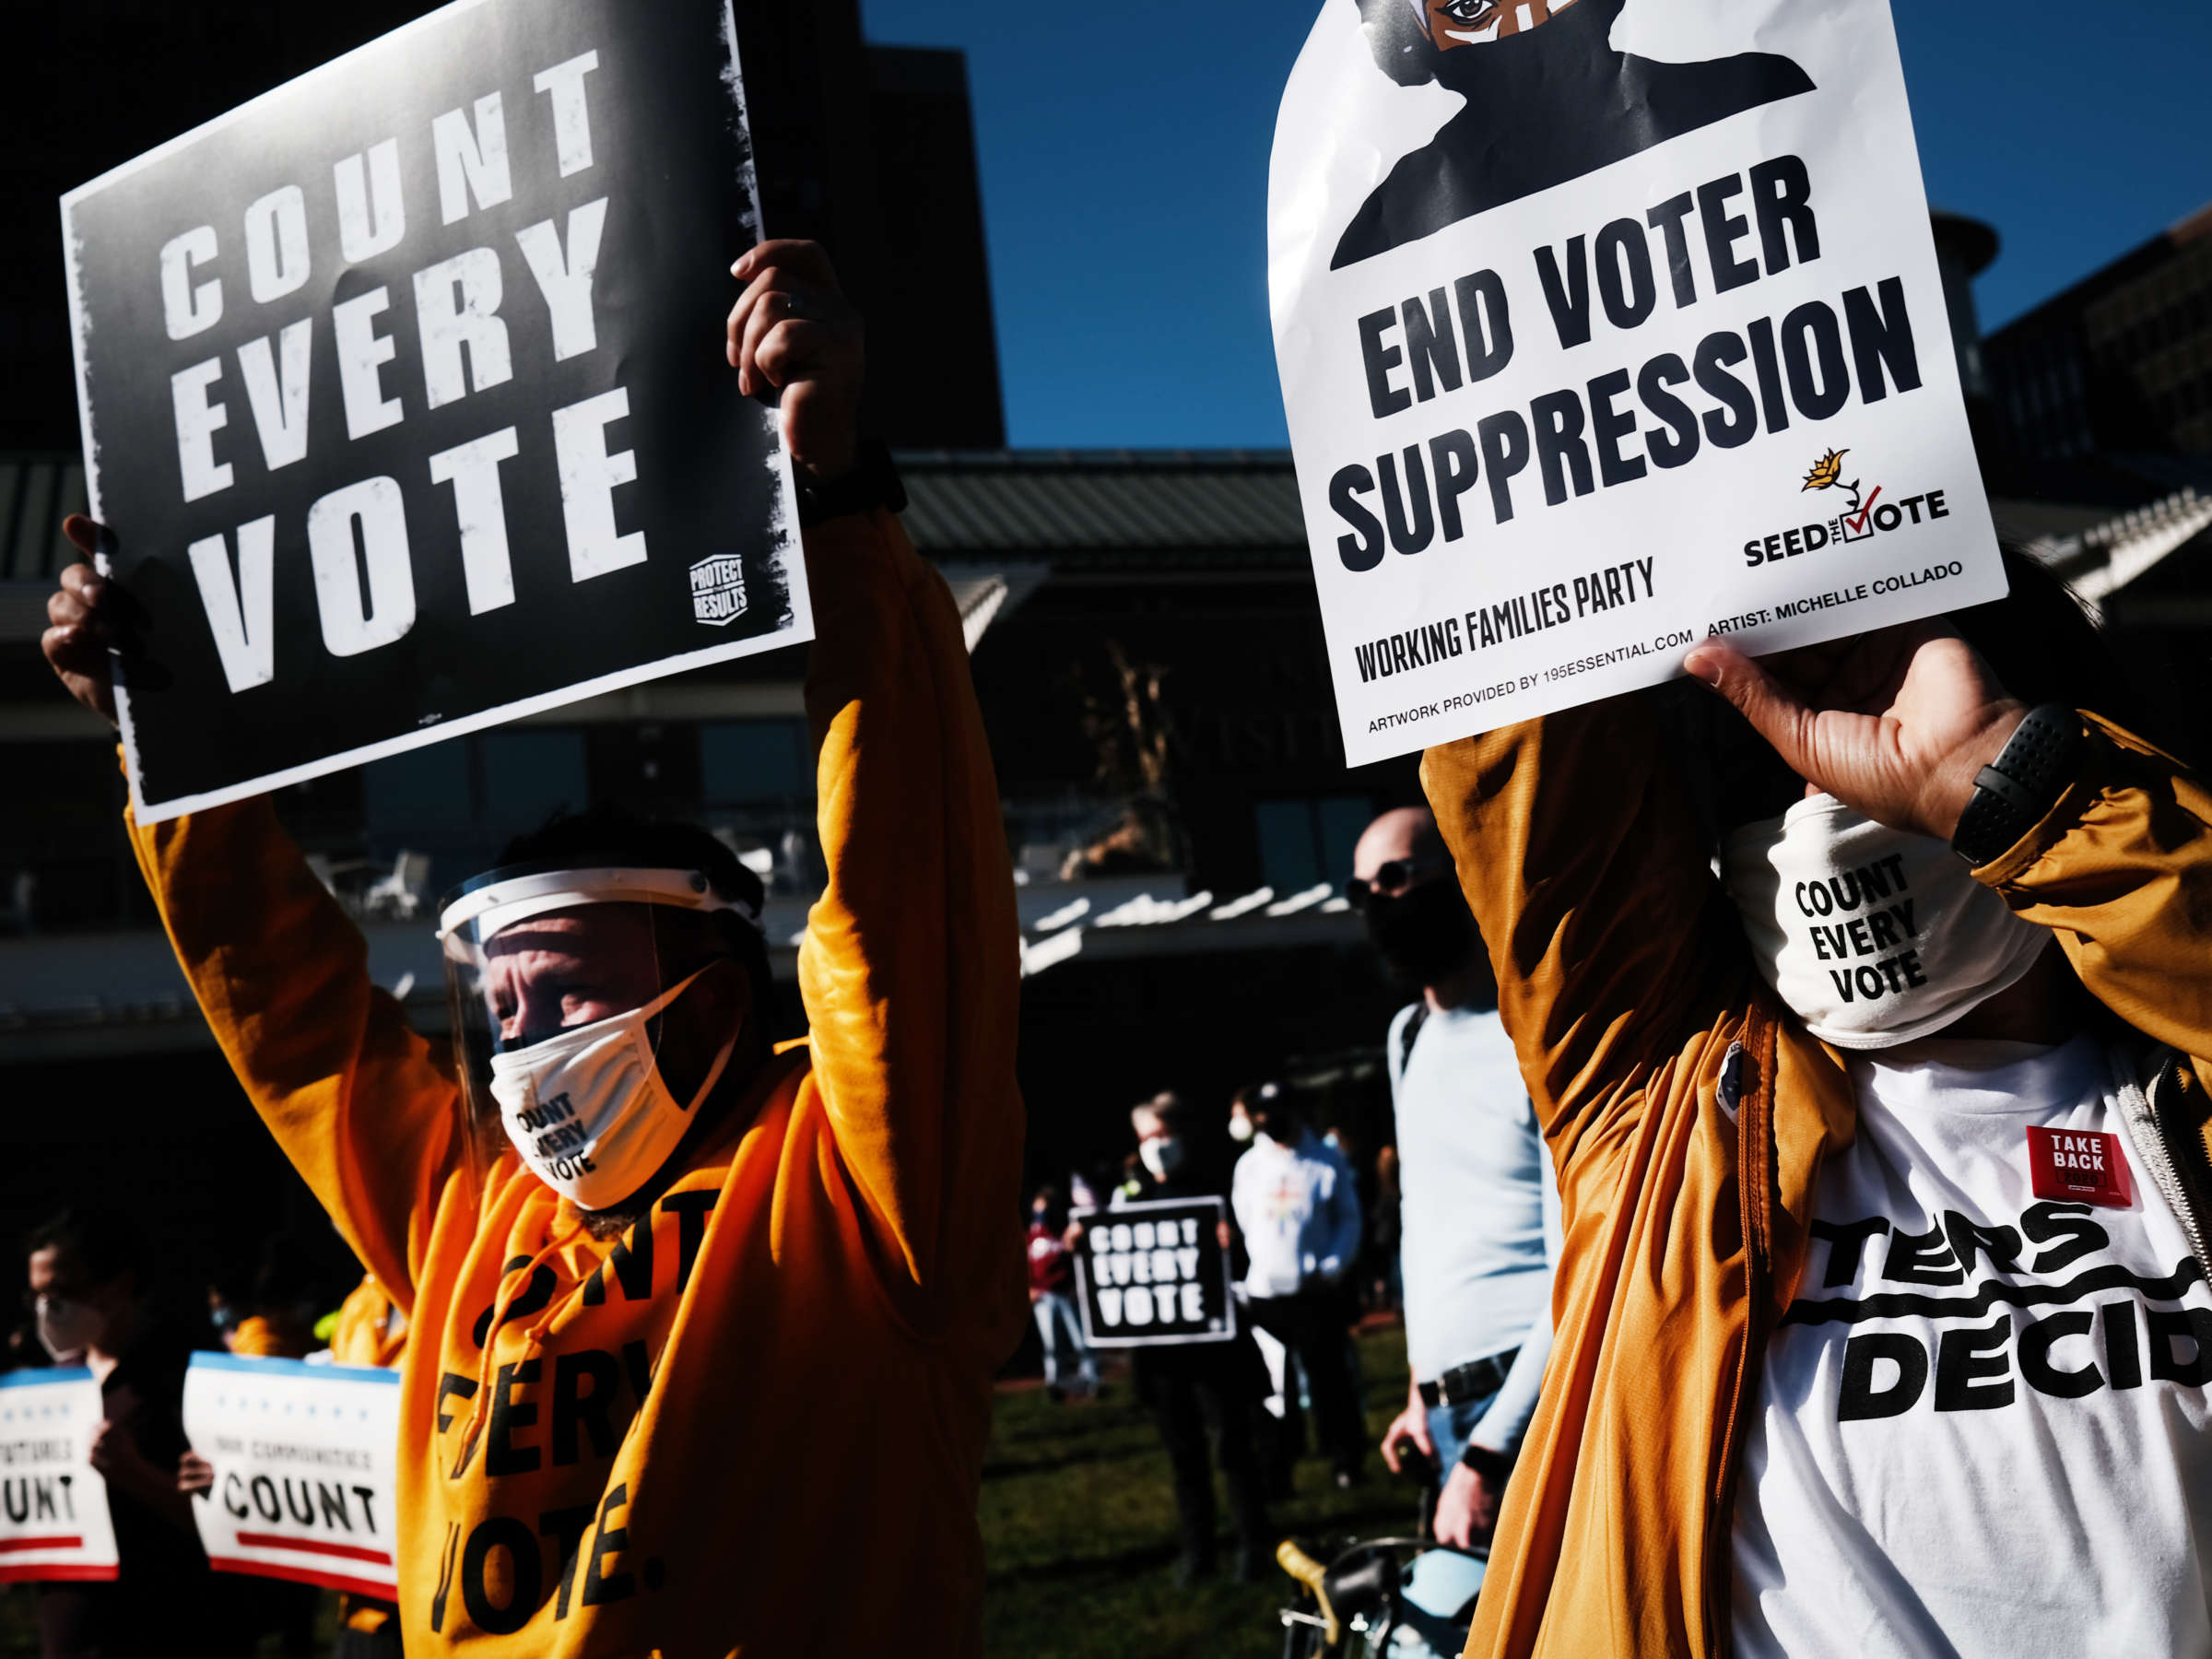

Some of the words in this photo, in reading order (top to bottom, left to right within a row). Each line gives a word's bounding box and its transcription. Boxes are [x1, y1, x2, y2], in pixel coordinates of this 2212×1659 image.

[160, 49, 599, 340] COUNT
[1358, 267, 1513, 418] END
[1533, 154, 1821, 350] VOTER
[171, 196, 608, 503] EVERY
[1329, 276, 1924, 572] SUPPRESSION
[189, 387, 648, 694] VOTE
[1744, 523, 1830, 568] SEED
[1829, 518, 1843, 546] THE
[689, 559, 743, 591] PROTECT
[693, 585, 747, 618] RESULTS
[1707, 609, 1772, 638] ARTIST:
[1775, 585, 1868, 620] MICHELLE
[1872, 560, 1963, 595] COLLADO
[1355, 617, 1463, 683] WORKING
[1465, 582, 1571, 652] FAMILIES
[1573, 556, 1654, 618] PARTY
[1369, 702, 1441, 734] ARTWORK
[1443, 681, 1516, 712] PROVIDED
[1520, 674, 1539, 690] BY
[1543, 629, 1694, 684] 195ESSENTIAL.COM
[1795, 853, 1909, 918] COUNT
[1809, 898, 1917, 960] EVERY
[1829, 949, 1928, 1004] VOTE
[2051, 1135, 2103, 1154] TAKE
[2053, 1152, 2105, 1171] BACK
[1097, 1282, 1206, 1327] VOTE
[1838, 1300, 2212, 1422] DECID
[224, 1472, 377, 1534] COUNT
